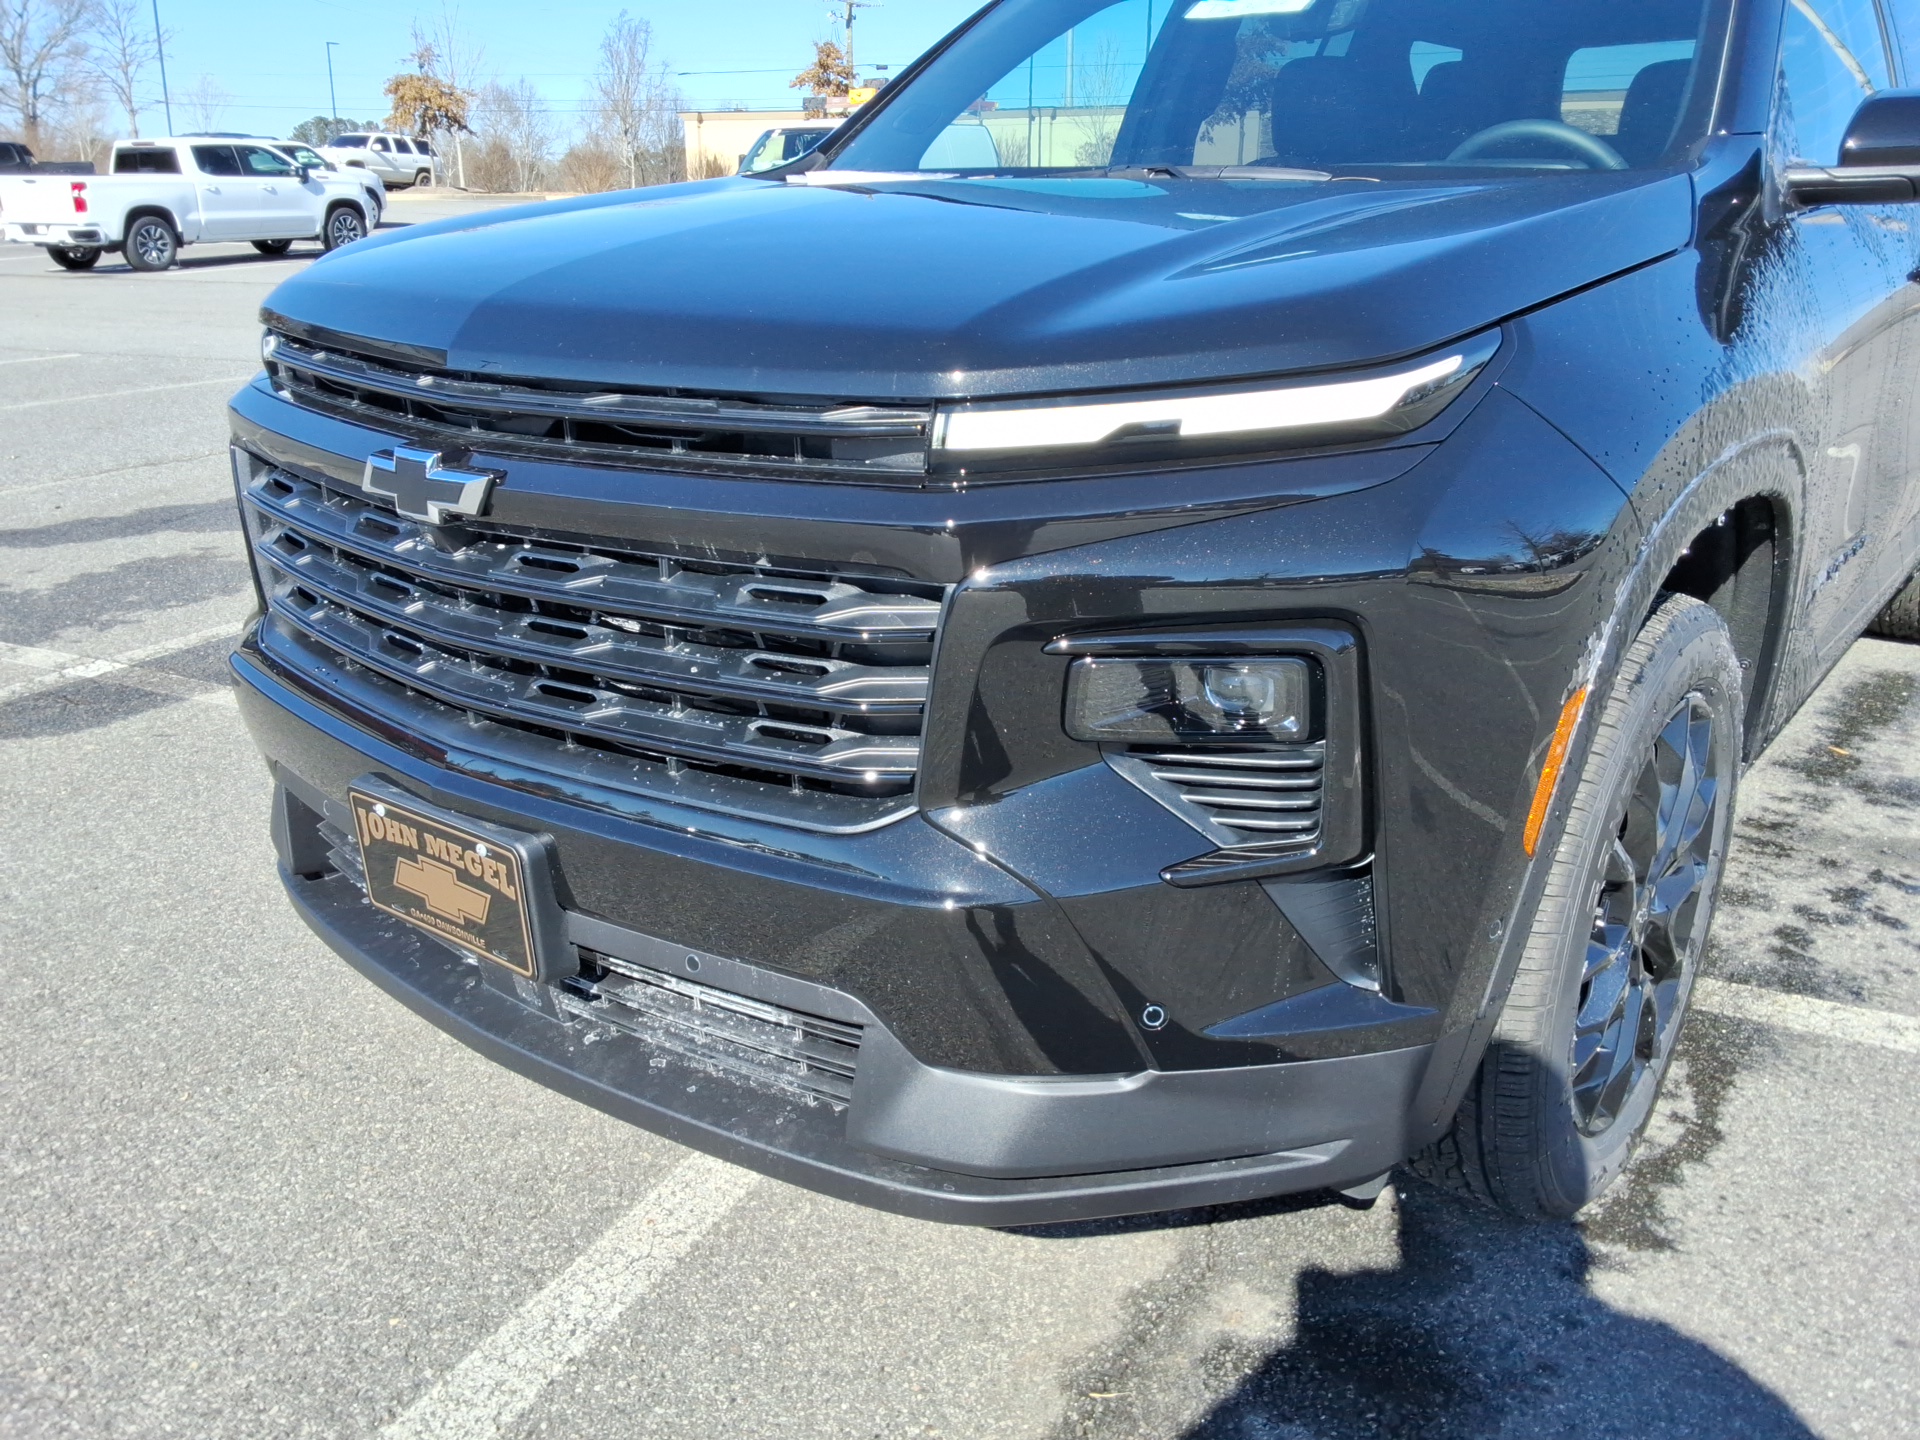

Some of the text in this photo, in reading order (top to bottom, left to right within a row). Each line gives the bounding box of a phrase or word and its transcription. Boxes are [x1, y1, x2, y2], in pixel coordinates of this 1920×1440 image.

[357, 807, 516, 900] JOHN MEGEL
[436, 918, 486, 949] DAWSONVILLE
